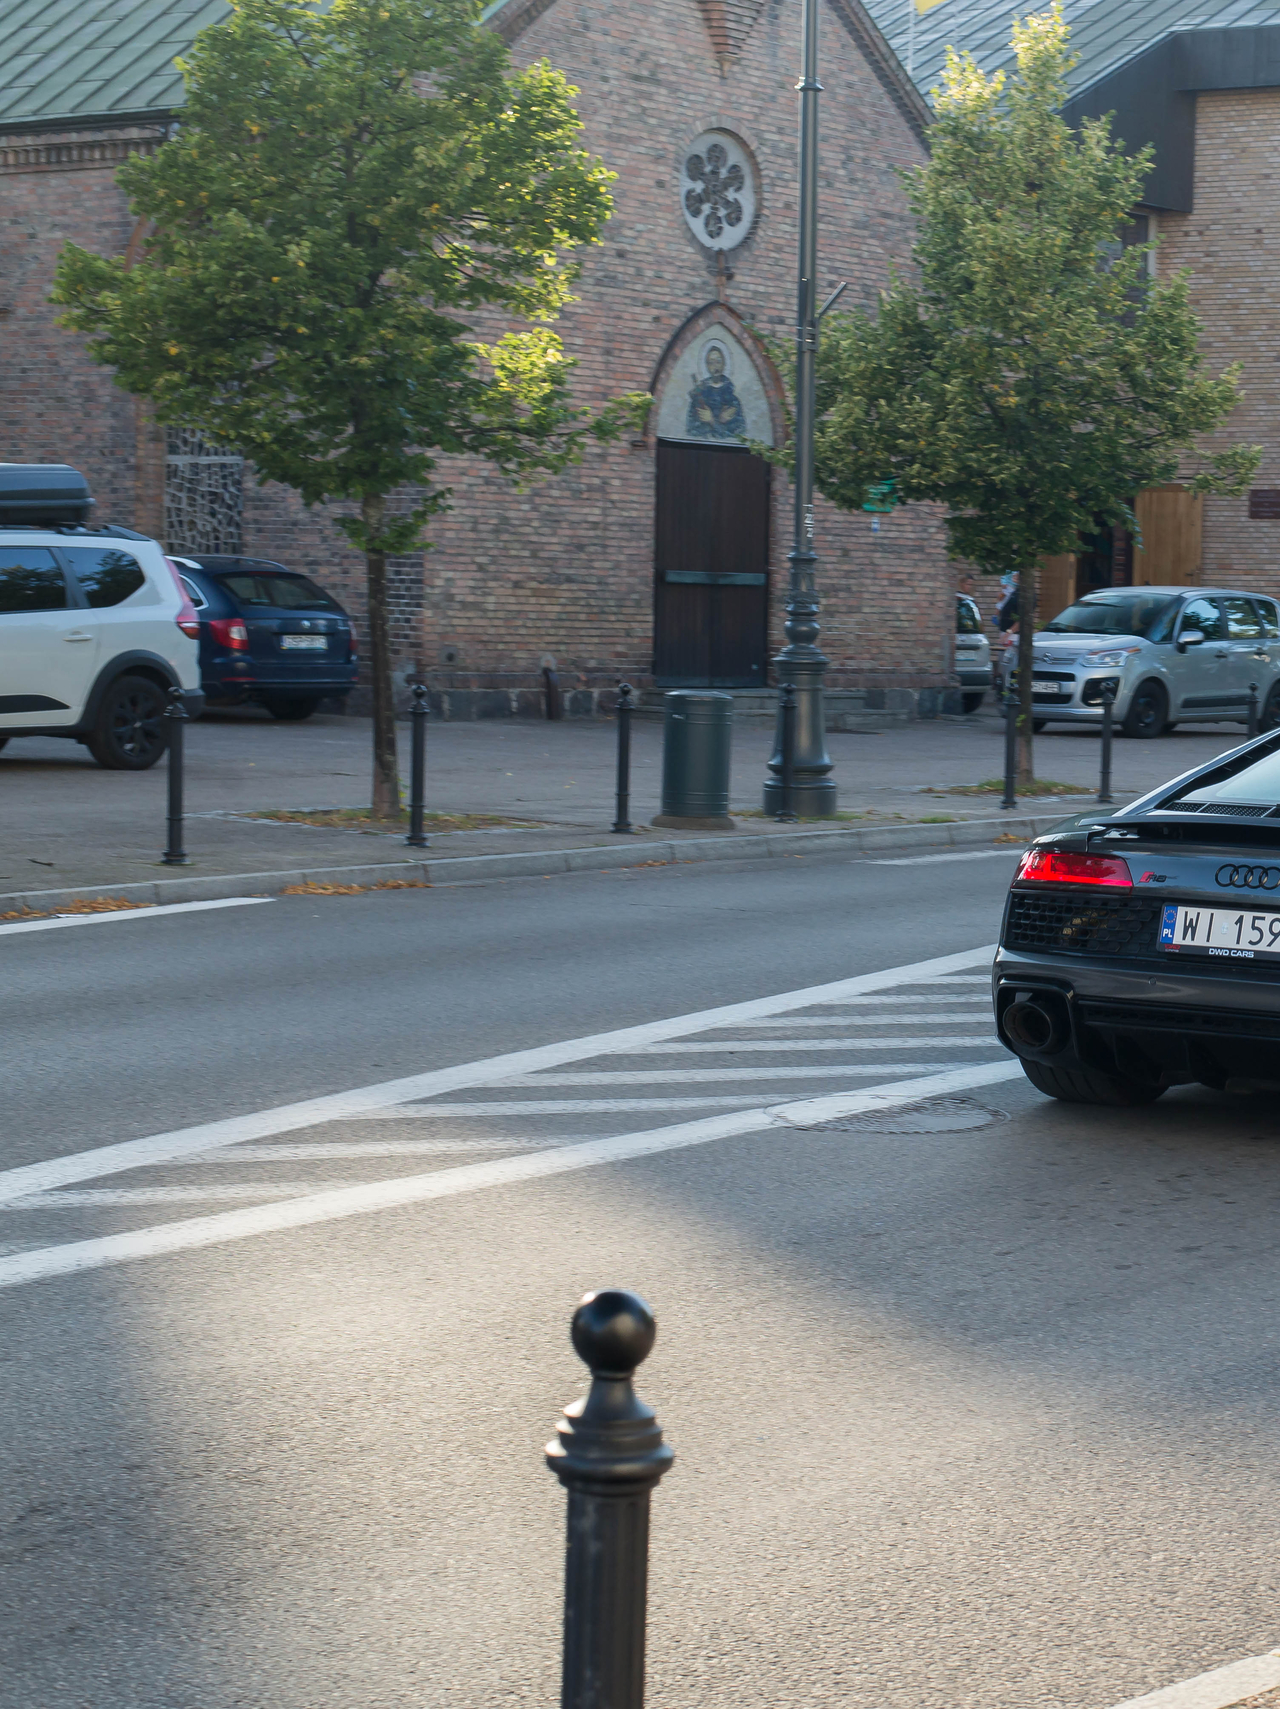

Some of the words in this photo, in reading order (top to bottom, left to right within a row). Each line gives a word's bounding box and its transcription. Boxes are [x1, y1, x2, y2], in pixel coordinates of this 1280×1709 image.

[1182, 910, 1215, 943] WI
[1162, 928, 1173, 938] PL
[1208, 948, 1229, 956] DWD
[1230, 949, 1255, 958] CARS
